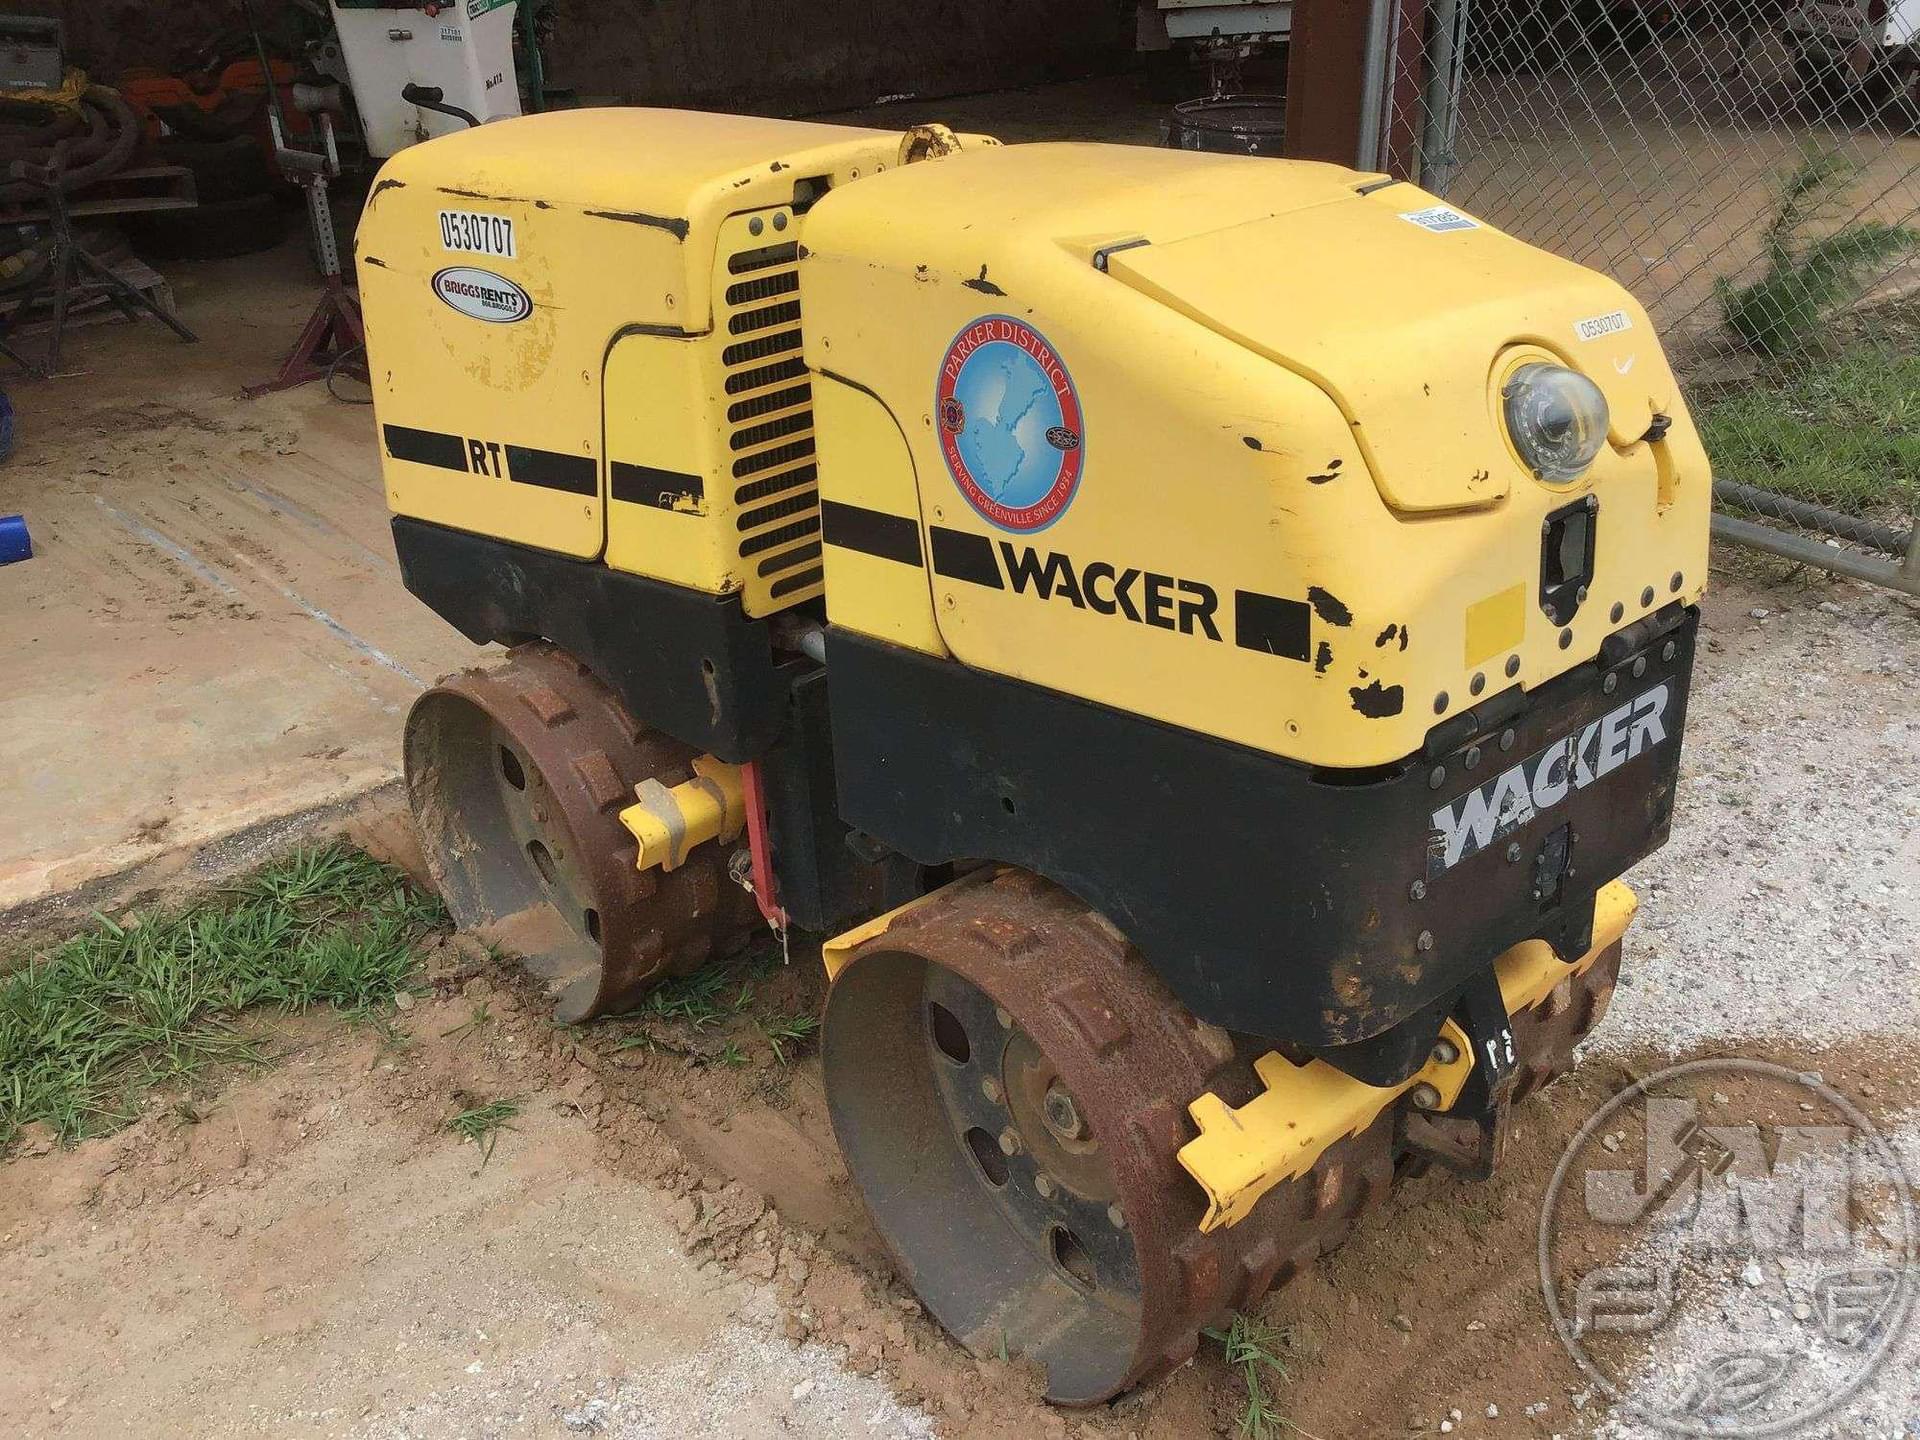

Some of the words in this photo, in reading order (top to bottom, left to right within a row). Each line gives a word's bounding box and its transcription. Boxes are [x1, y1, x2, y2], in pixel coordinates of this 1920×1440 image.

[440, 212, 512, 256] 0530707
[944, 321, 999, 381] PARKER
[1001, 320, 1072, 396] DISTRICT
[1581, 313, 1626, 338] 0530707
[467, 438, 502, 478] RT
[947, 446, 976, 497] SERVING
[977, 495, 1034, 524] GREENVILLE
[1034, 497, 1060, 520] SINCE
[998, 540, 1224, 643] WACKER
[1430, 684, 1669, 869] WACKER
